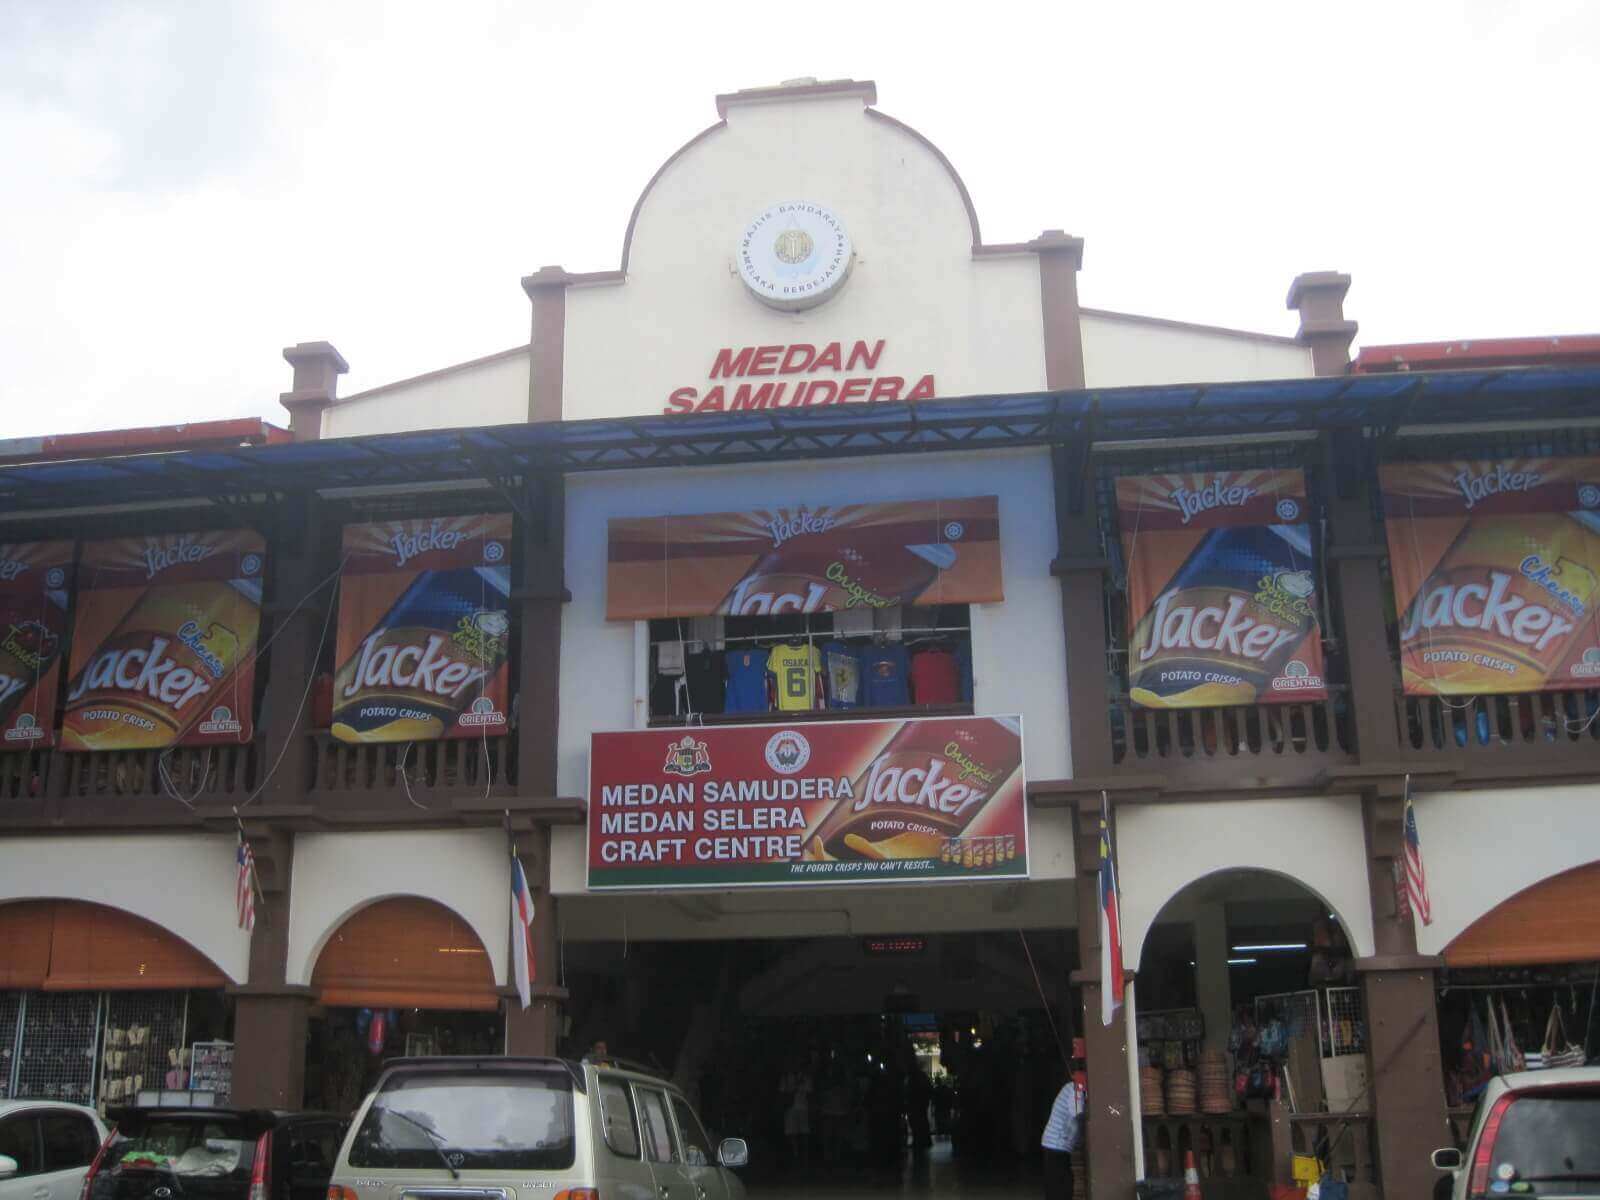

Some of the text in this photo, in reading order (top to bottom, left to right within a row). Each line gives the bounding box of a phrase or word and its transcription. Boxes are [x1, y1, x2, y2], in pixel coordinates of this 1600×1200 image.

[742, 204, 844, 247] MAJLIS BANDARAYA
[743, 249, 844, 294] MELAKA BERSEJARAH
[708, 339, 886, 380] MEDAN
[663, 374, 936, 415] SAMUDERA
[1171, 479, 1257, 524] Jacker
[1455, 464, 1542, 509] Jacker
[389, 521, 467, 567] Jacker
[767, 511, 835, 548] Jacker
[144, 535, 213, 579] Jacker
[1520, 554, 1584, 616] Cheese
[1140, 586, 1299, 661] Jacker
[1401, 571, 1573, 651] Jacker
[68, 636, 211, 709] Jacker
[345, 627, 491, 698] Jacker
[1161, 670, 1242, 685] POTATO CRISPS
[1424, 650, 1519, 673] POTATO CRISPS
[787, 668, 806, 697] 6
[1273, 678, 1322, 689] ORIENTAL
[82, 710, 157, 731] POTATO CRISPS
[360, 707, 432, 721] POTATO CRISPS
[944, 741, 1002, 783] Original
[601, 777, 855, 807] MEDAN SAMUDERA
[854, 751, 988, 816] Jacker
[601, 806, 807, 834] MEDAN SELERA
[870, 821, 939, 836] POTATO CRISPS
[601, 835, 802, 863] CRAFT CENTRE
[790, 864, 805, 873] THE
[806, 864, 833, 873] POTATO
[834, 863, 862, 873] CRISPS
[863, 862, 879, 871] YOU
[880, 861, 902, 871] CAN'T
